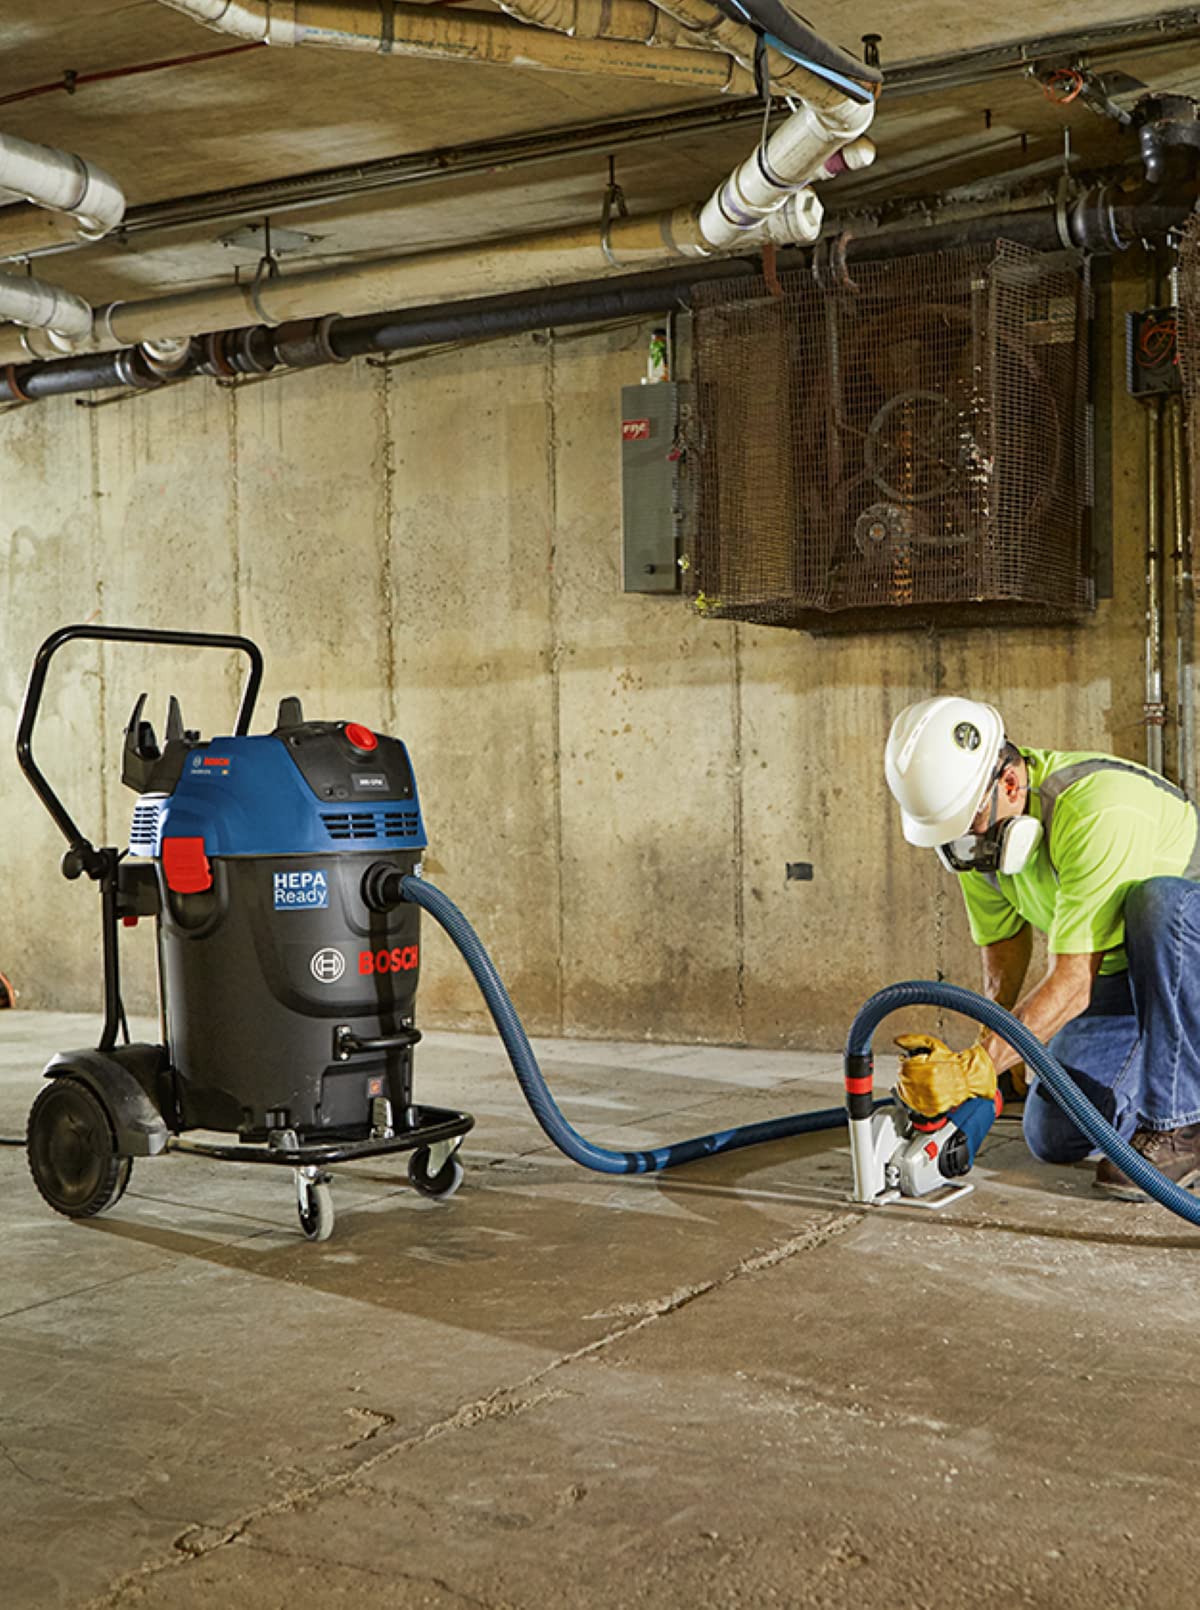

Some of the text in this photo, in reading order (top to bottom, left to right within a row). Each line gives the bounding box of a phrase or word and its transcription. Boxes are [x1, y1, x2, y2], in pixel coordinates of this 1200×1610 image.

[274, 872, 326, 888] HEPA
[275, 888, 327, 905] Ready
[358, 944, 418, 976] BOSCH
